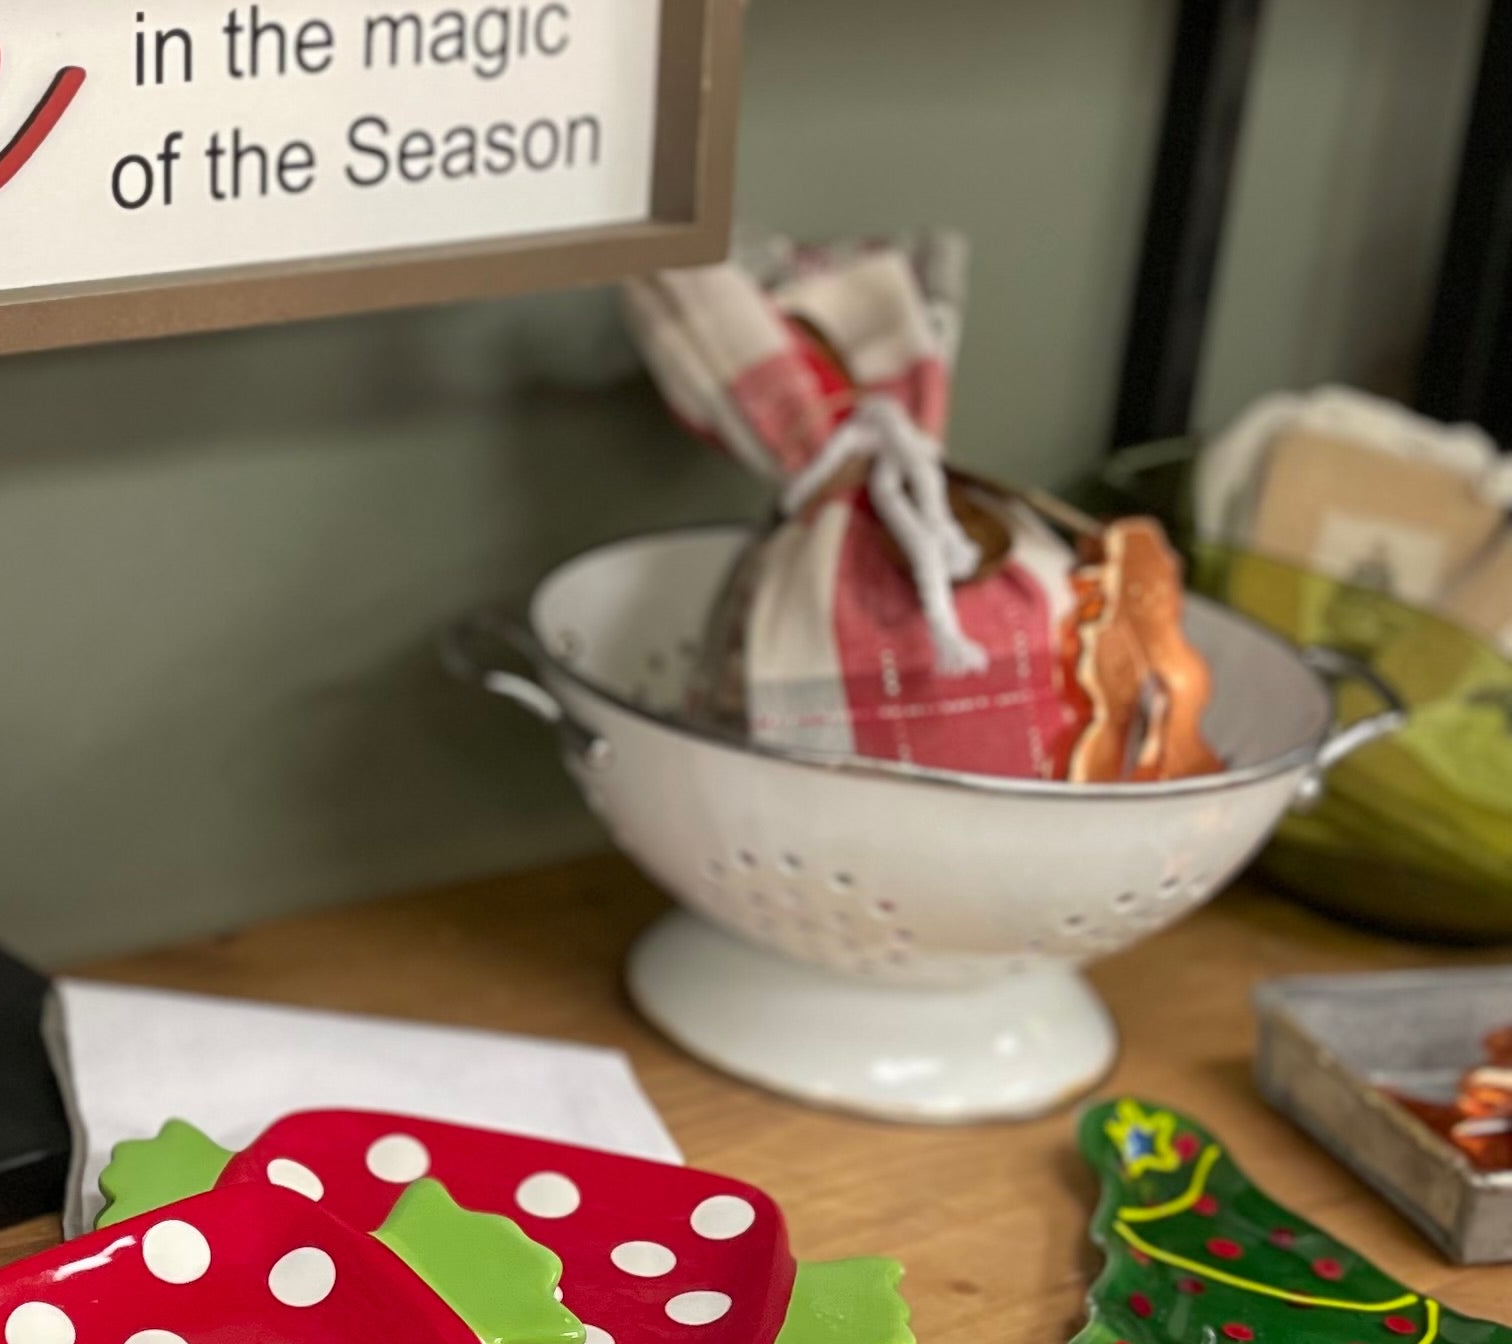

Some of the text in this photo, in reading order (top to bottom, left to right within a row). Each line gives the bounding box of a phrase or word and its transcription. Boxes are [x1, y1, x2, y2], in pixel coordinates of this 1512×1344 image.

[133, 11, 194, 86] in
[224, 5, 334, 80] the
[110, 112, 602, 211] of the Season
